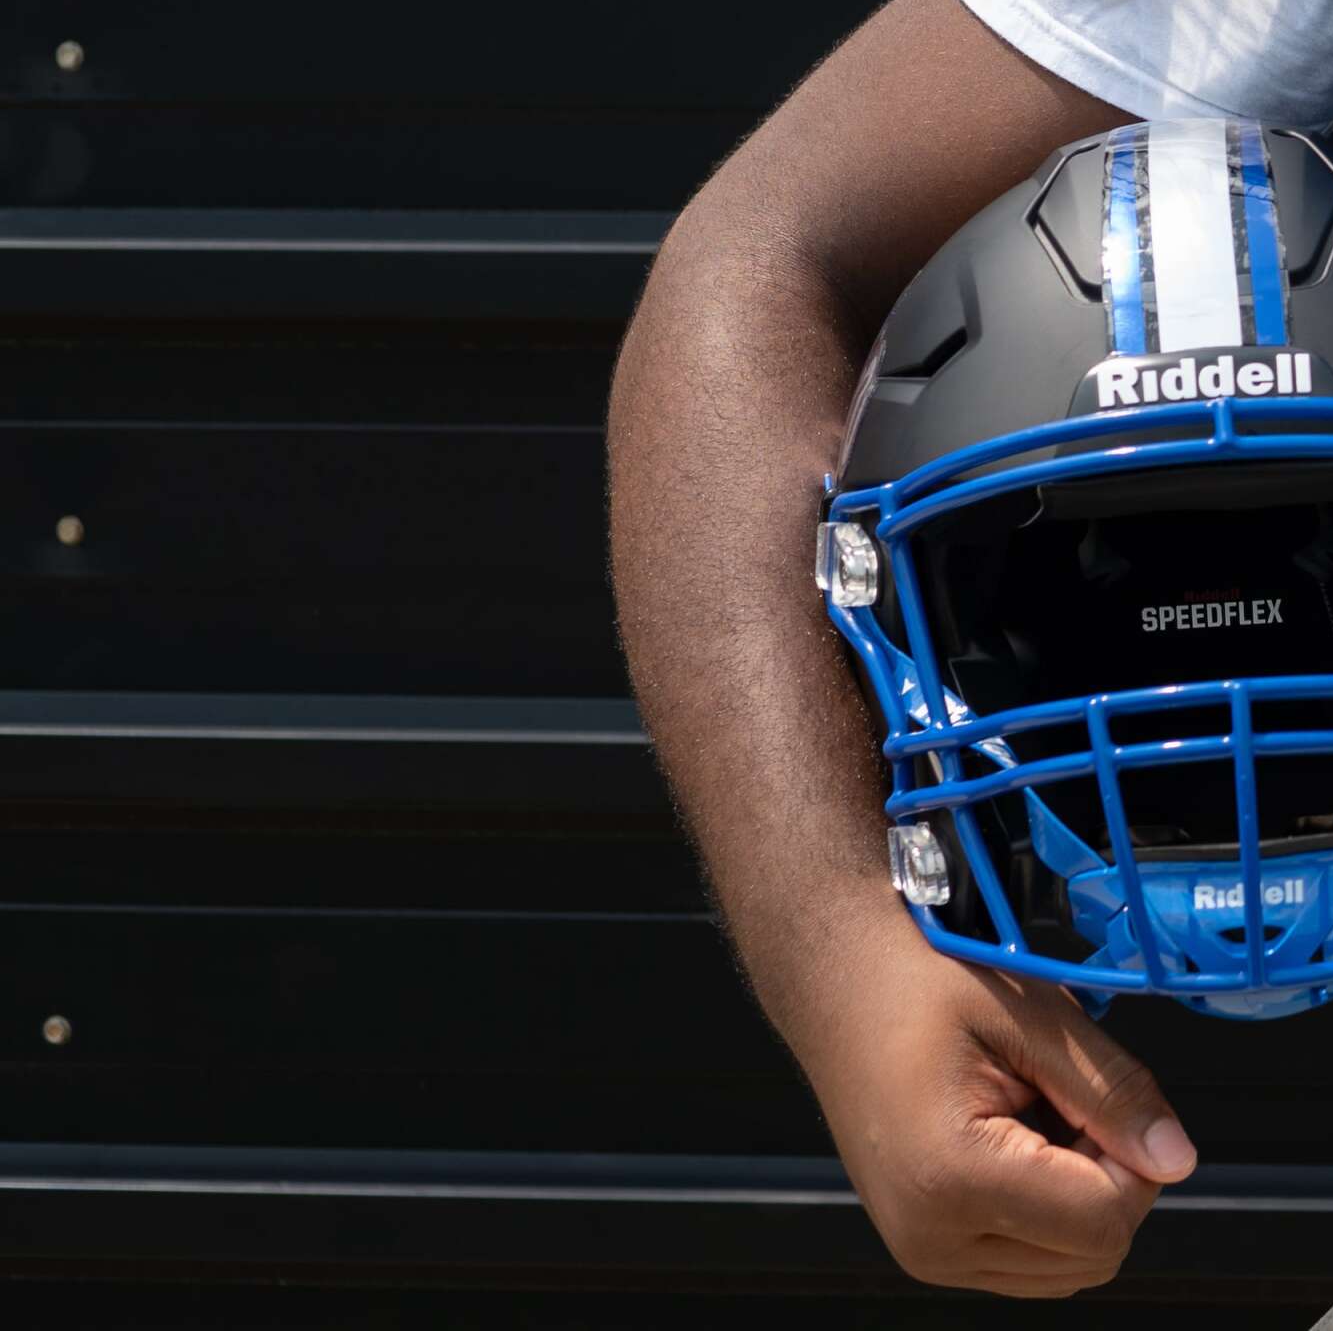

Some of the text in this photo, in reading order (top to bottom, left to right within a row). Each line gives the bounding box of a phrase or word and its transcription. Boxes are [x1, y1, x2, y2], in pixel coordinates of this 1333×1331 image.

[1097, 353, 1312, 408] Riddell
[1141, 598, 1284, 632] SPEEDFLEX
[1194, 879, 1304, 910] Ridell
